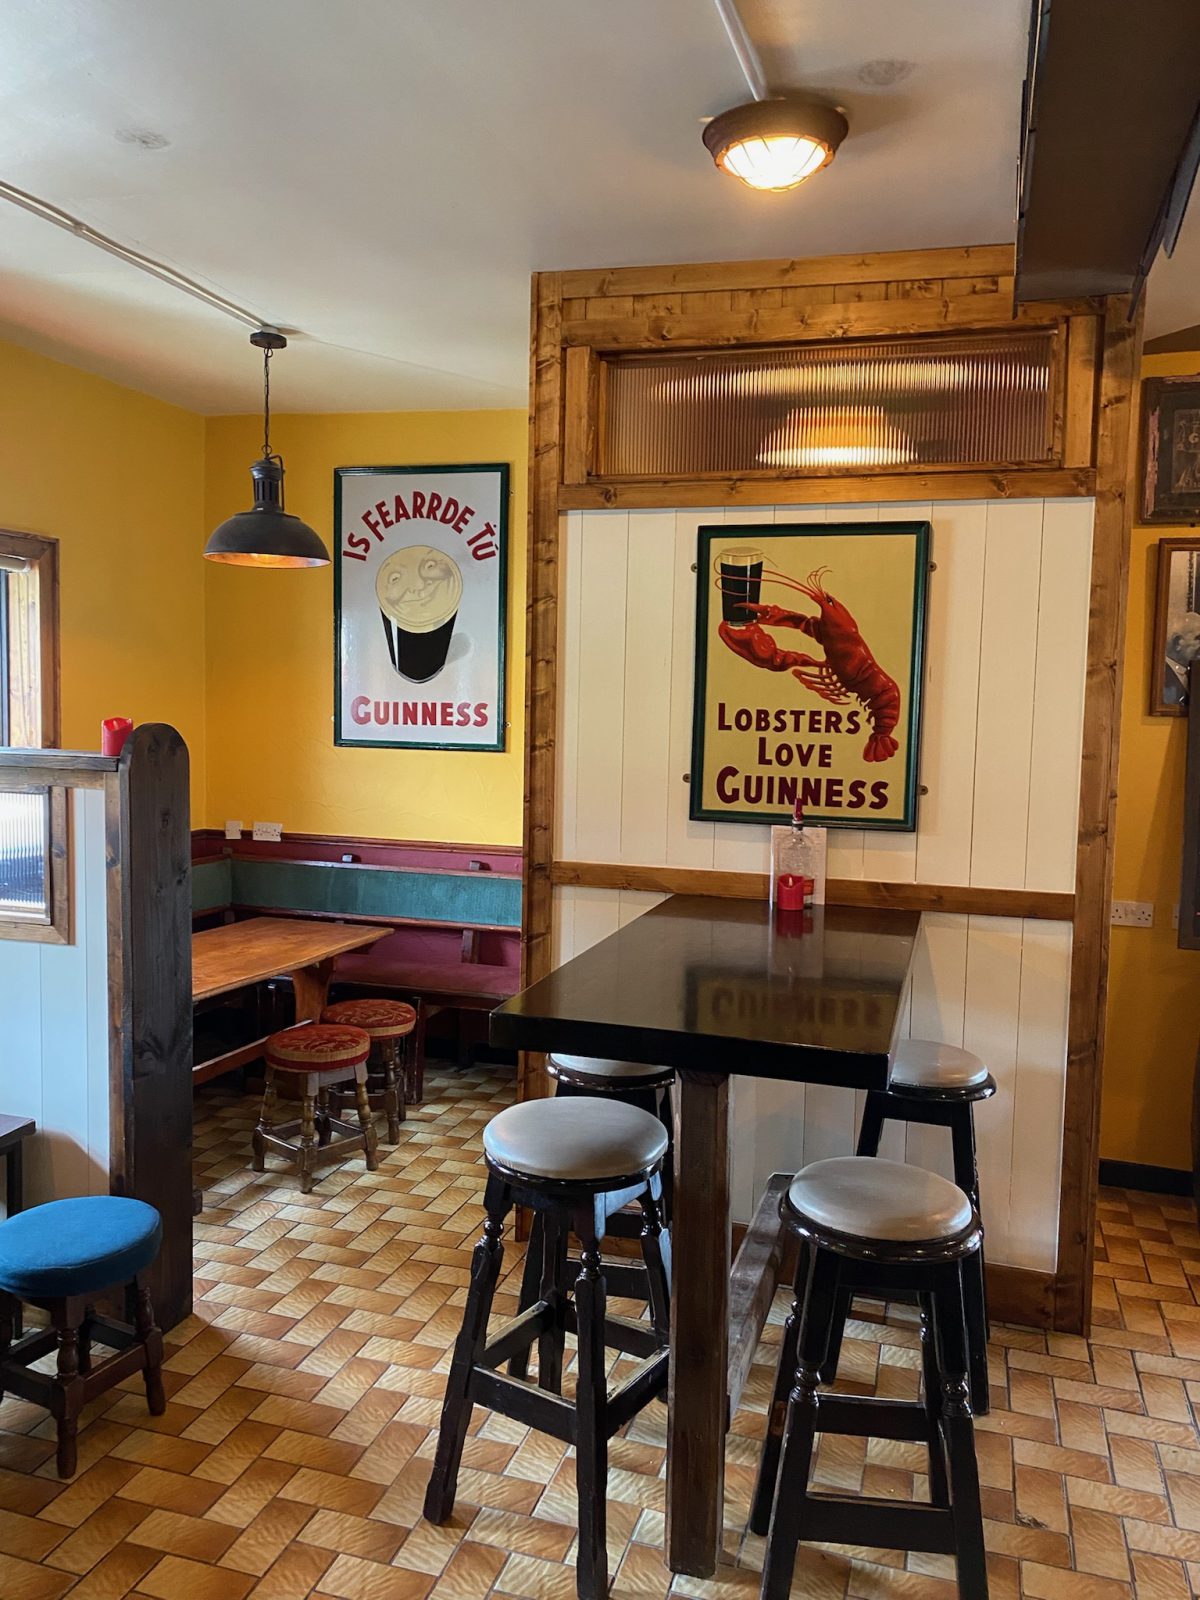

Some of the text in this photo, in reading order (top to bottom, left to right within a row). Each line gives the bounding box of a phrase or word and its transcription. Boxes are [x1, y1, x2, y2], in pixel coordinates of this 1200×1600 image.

[342, 532, 371, 561] IS
[361, 491, 475, 542] FEARRDE
[351, 695, 489, 728] GUINNESS
[717, 702, 861, 735] LOBSTERS
[757, 736, 832, 768] LOVE
[716, 765, 890, 810] GUINNESS
